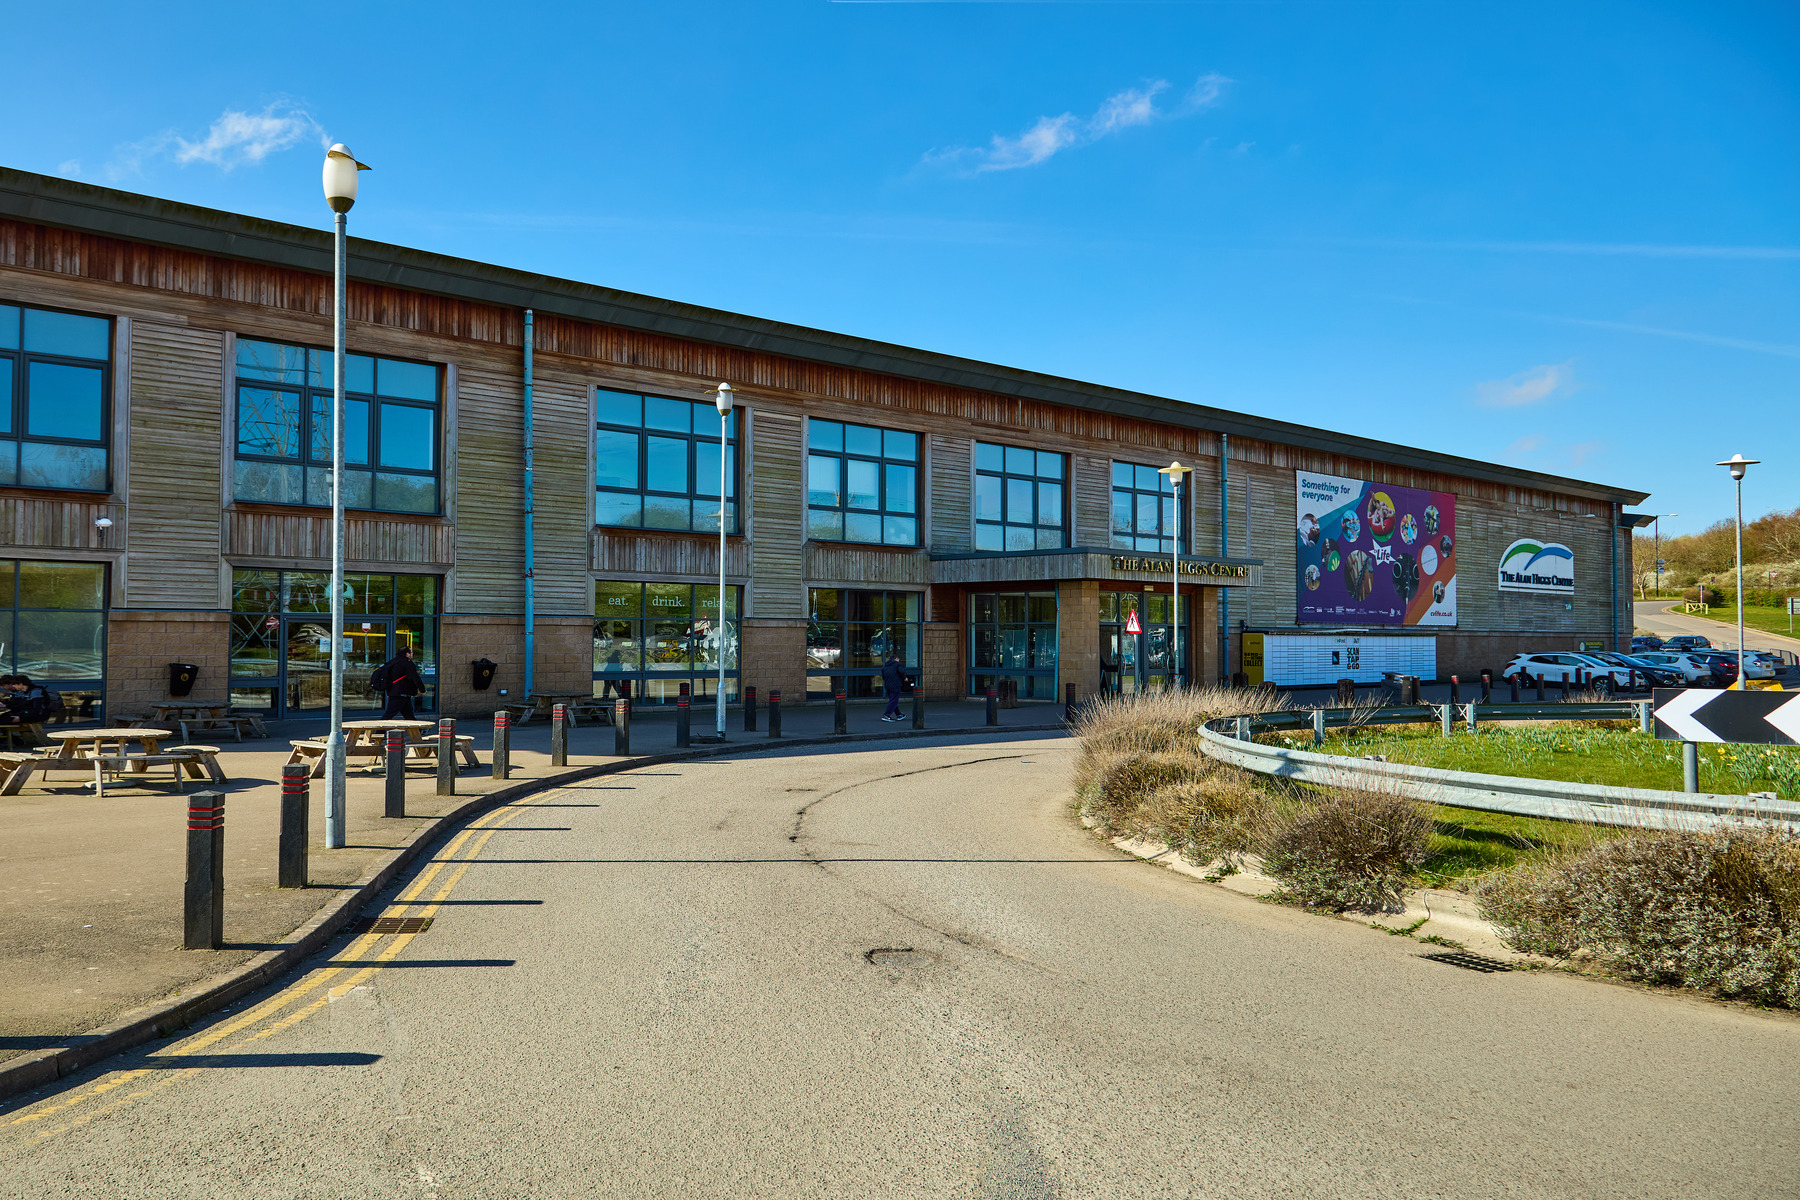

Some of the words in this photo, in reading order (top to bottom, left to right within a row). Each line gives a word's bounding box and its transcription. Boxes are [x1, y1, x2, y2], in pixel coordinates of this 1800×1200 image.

[1302, 479, 1339, 494] Something
[1340, 485, 1350, 494] for
[1302, 491, 1333, 502] everyone
[1113, 556, 1138, 571] THE
[1141, 558, 1172, 573] ALAN
[1211, 563, 1250, 577] CENTRE
[1501, 571, 1515, 582] THE
[1515, 573, 1532, 584] ALAN
[1532, 574, 1551, 585] HIGGS
[1551, 575, 1574, 586] CENTRE
[608, 596, 629, 606] eat.
[652, 595, 685, 607] drink.
[1347, 647, 1360, 655] SCAN
